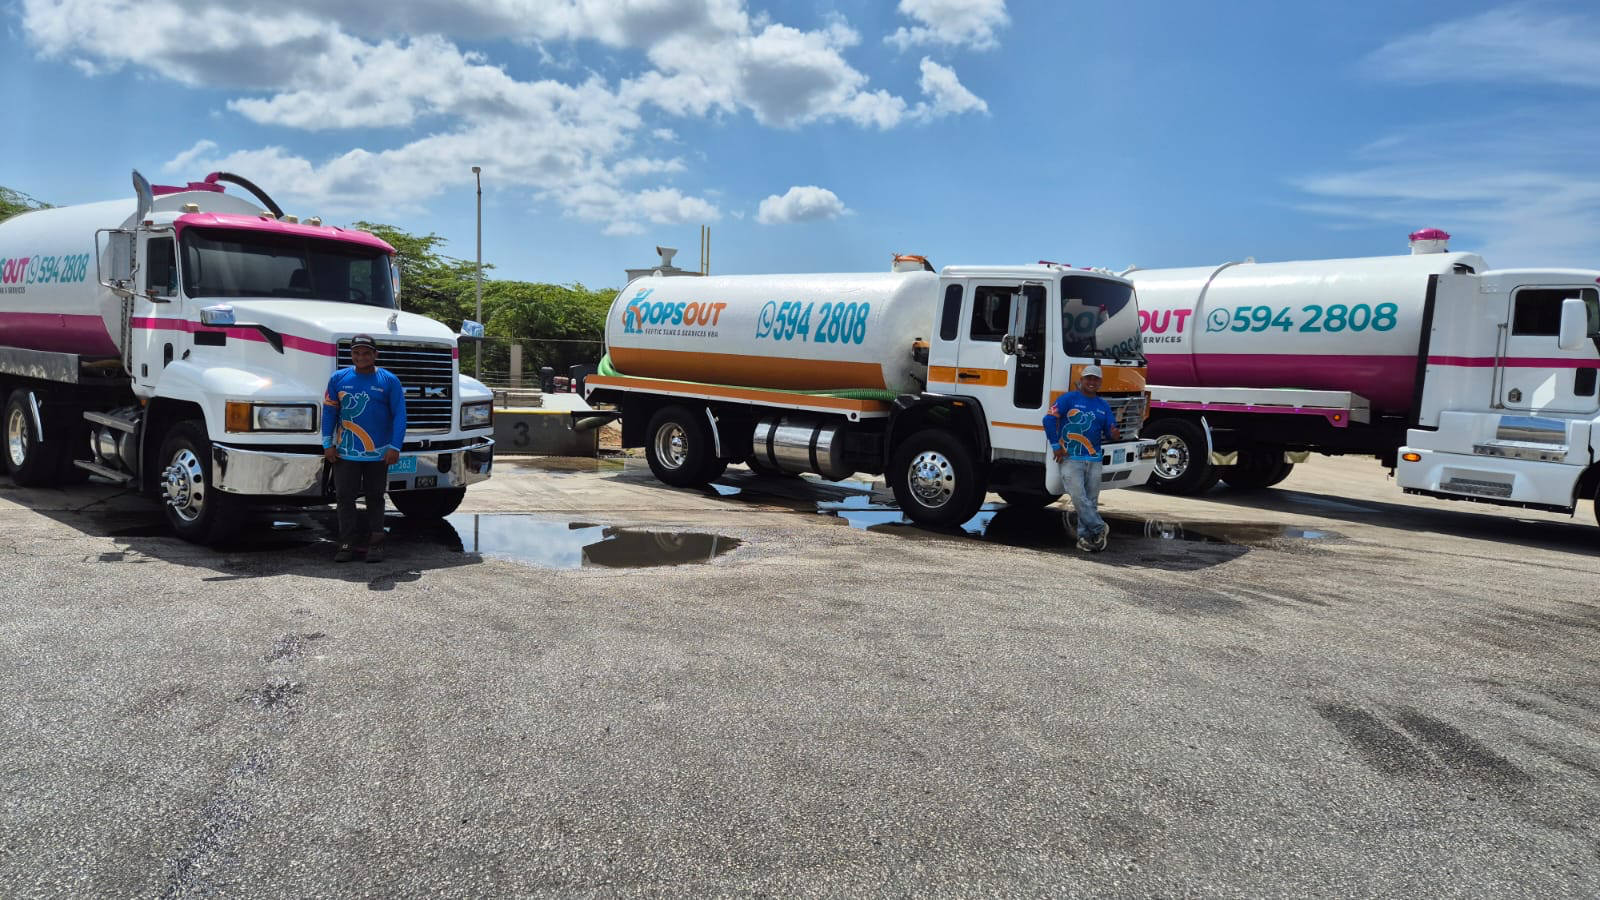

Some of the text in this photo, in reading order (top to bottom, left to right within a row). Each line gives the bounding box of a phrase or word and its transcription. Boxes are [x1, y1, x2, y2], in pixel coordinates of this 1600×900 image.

[37, 253, 89, 283] 594 2808
[773, 301, 871, 345] 594 2808
[1230, 302, 1399, 333] 594 2808
[513, 421, 531, 447] 3
